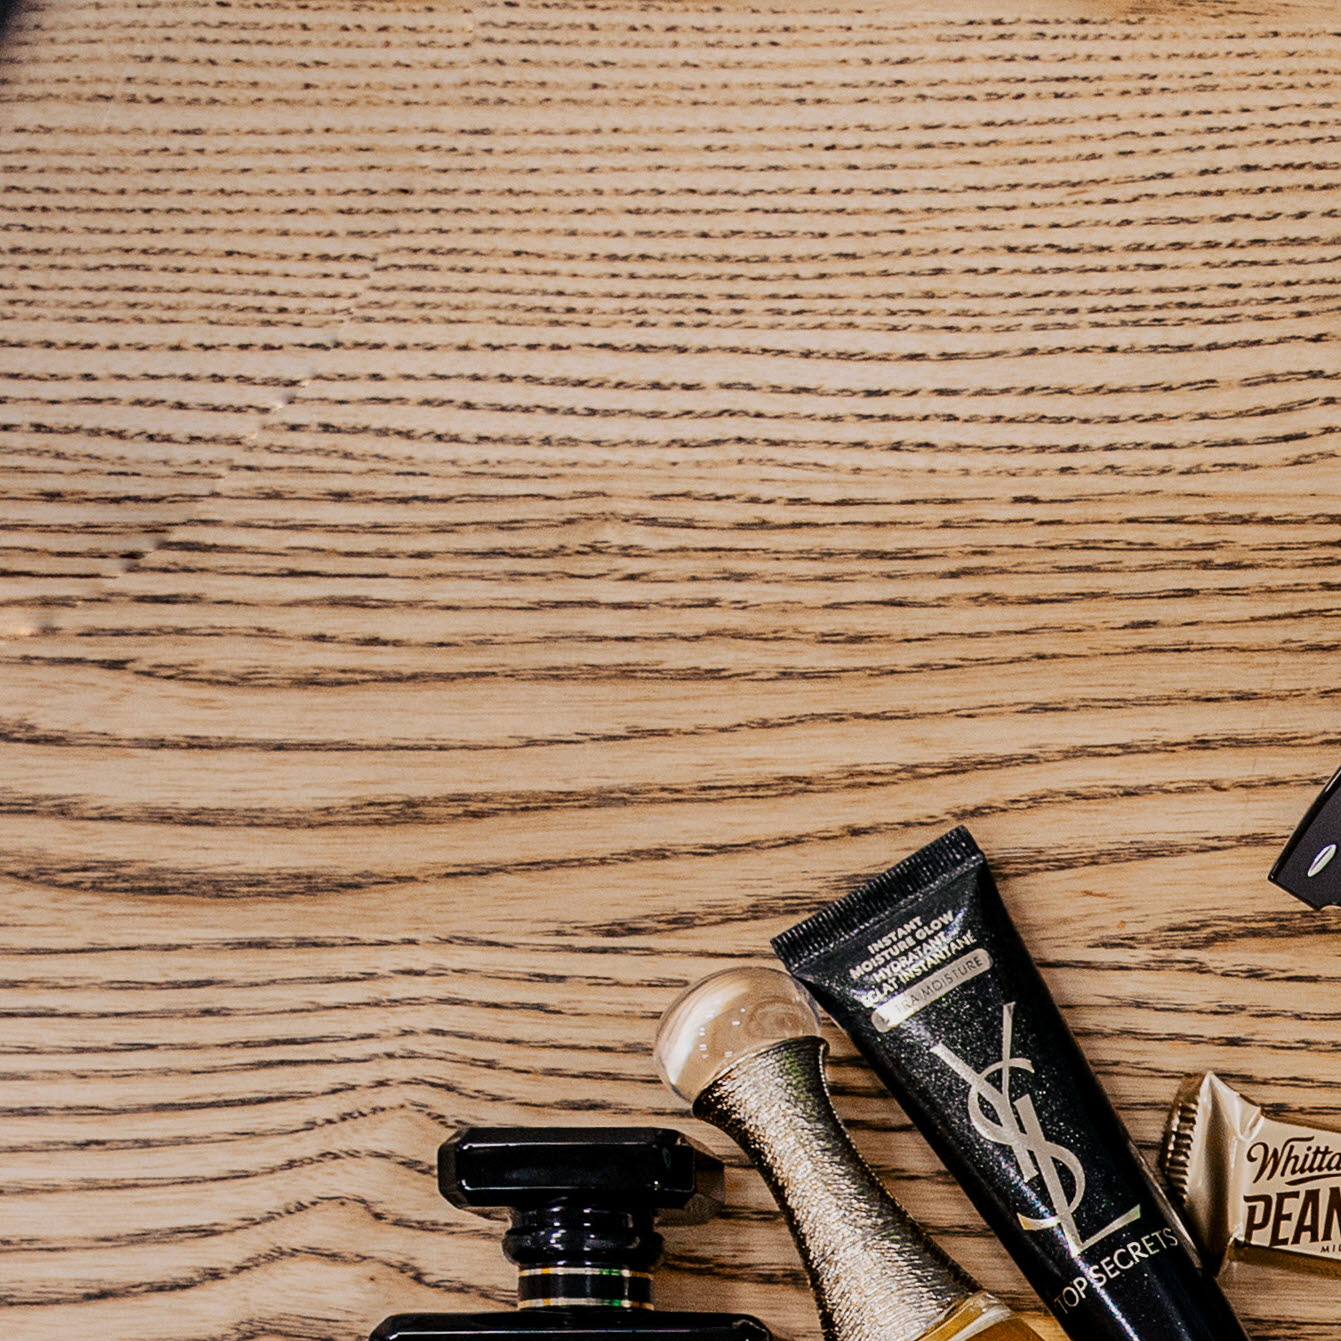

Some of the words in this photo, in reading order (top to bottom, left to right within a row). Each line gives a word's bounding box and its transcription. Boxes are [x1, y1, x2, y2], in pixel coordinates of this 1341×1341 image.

[850, 937, 916, 979] MOISTURE
[916, 910, 954, 940] GLOW
[868, 916, 923, 954] INSTANT
[1054, 1277, 1088, 1314] TOP
[1089, 1227, 1178, 1288] SECRETS
